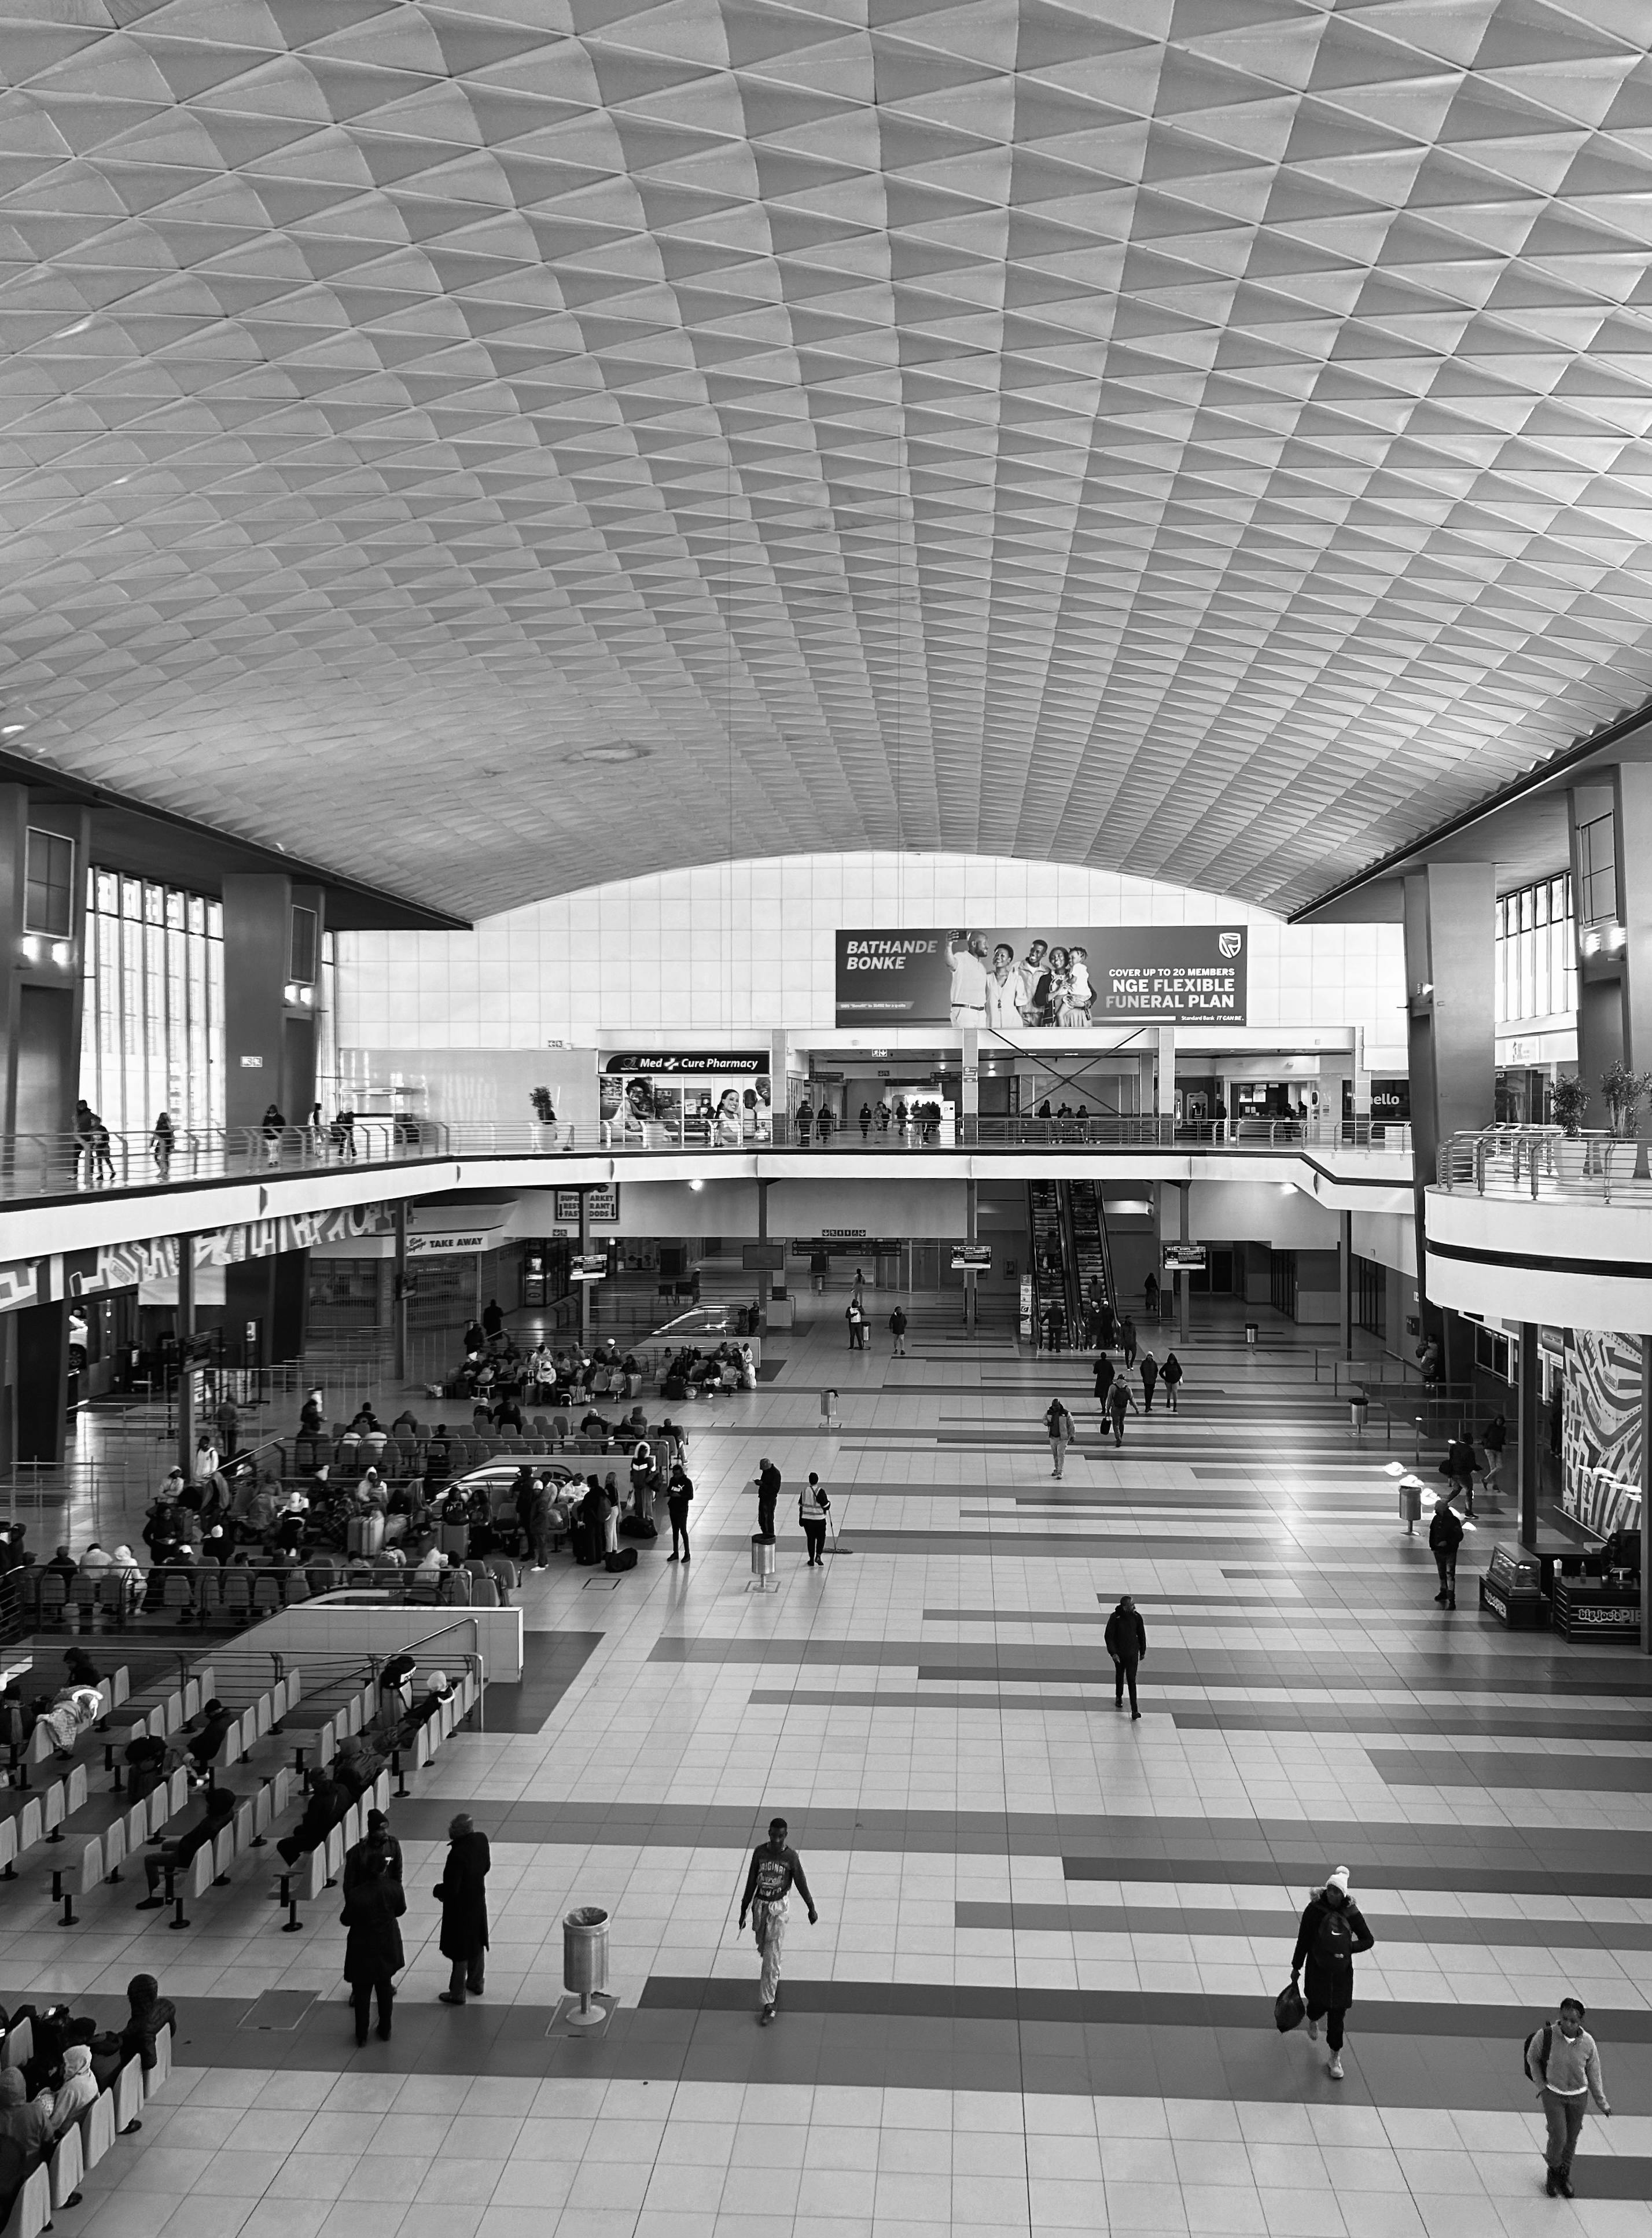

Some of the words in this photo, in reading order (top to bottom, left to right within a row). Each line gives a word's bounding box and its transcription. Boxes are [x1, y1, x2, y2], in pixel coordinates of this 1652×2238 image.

[847, 940, 938, 954] BATHANDE
[847, 956, 906, 970] BONKE
[1109, 969, 1140, 977] COVER
[1143, 969, 1156, 977] UP
[1158, 969, 1171, 977] TO
[1187, 968, 1235, 976] MEMBERS
[1113, 979, 1149, 992] NGE
[1154, 978, 1235, 992] FLEXIBLE
[1106, 995, 1184, 1008] FUNERAL
[1189, 995, 1234, 1008] PLAN
[640, 1058, 663, 1068] Med
[682, 1058, 705, 1068] Cure
[707, 1058, 758, 1070] Pharmacy
[430, 1239, 454, 1247] TAKE
[457, 1237, 483, 1246] AWAY
[1579, 1609, 1595, 1622] big
